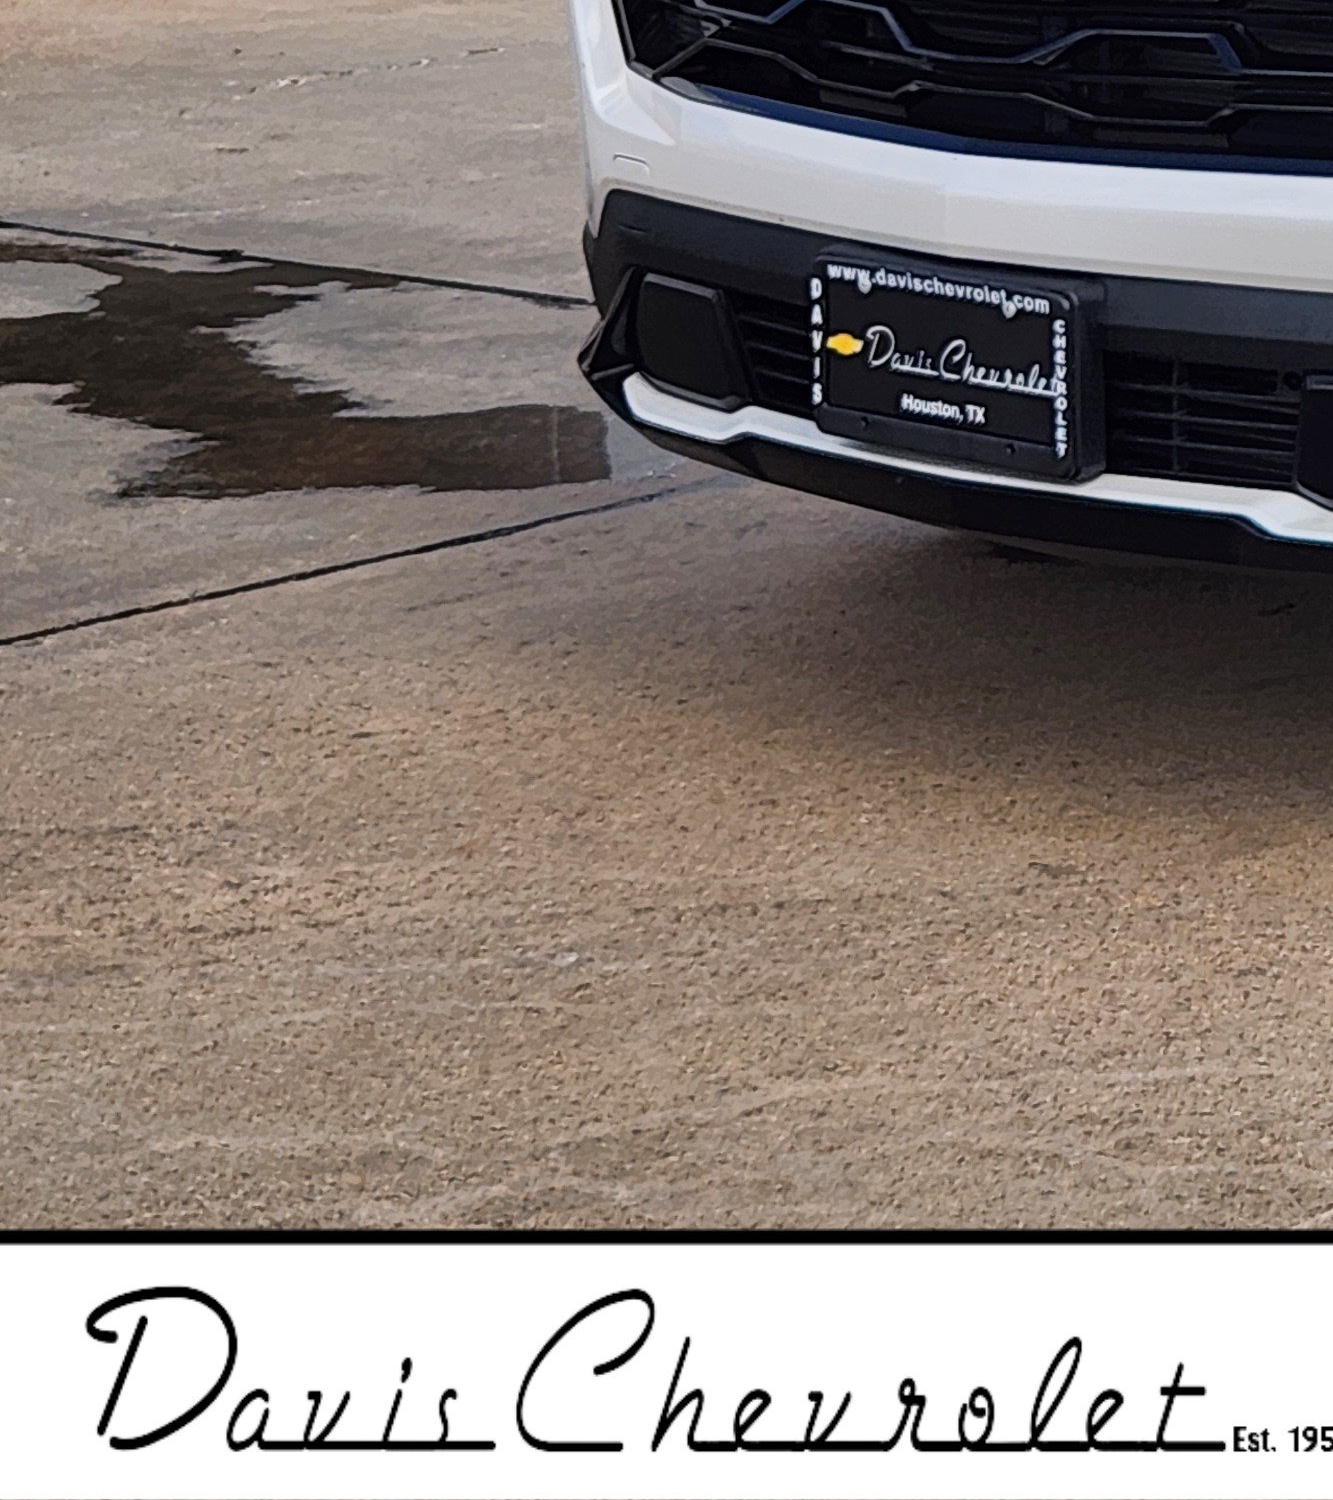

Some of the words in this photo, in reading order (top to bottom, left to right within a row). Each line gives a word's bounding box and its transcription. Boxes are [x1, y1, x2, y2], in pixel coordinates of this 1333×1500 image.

[826, 263, 1050, 315] www.davischevrolet.com
[810, 278, 823, 405] DAVIS
[866, 325, 939, 377] Davis
[939, 339, 1059, 397] Chevrolet
[901, 393, 963, 421] Houston,
[965, 404, 986, 425] TX
